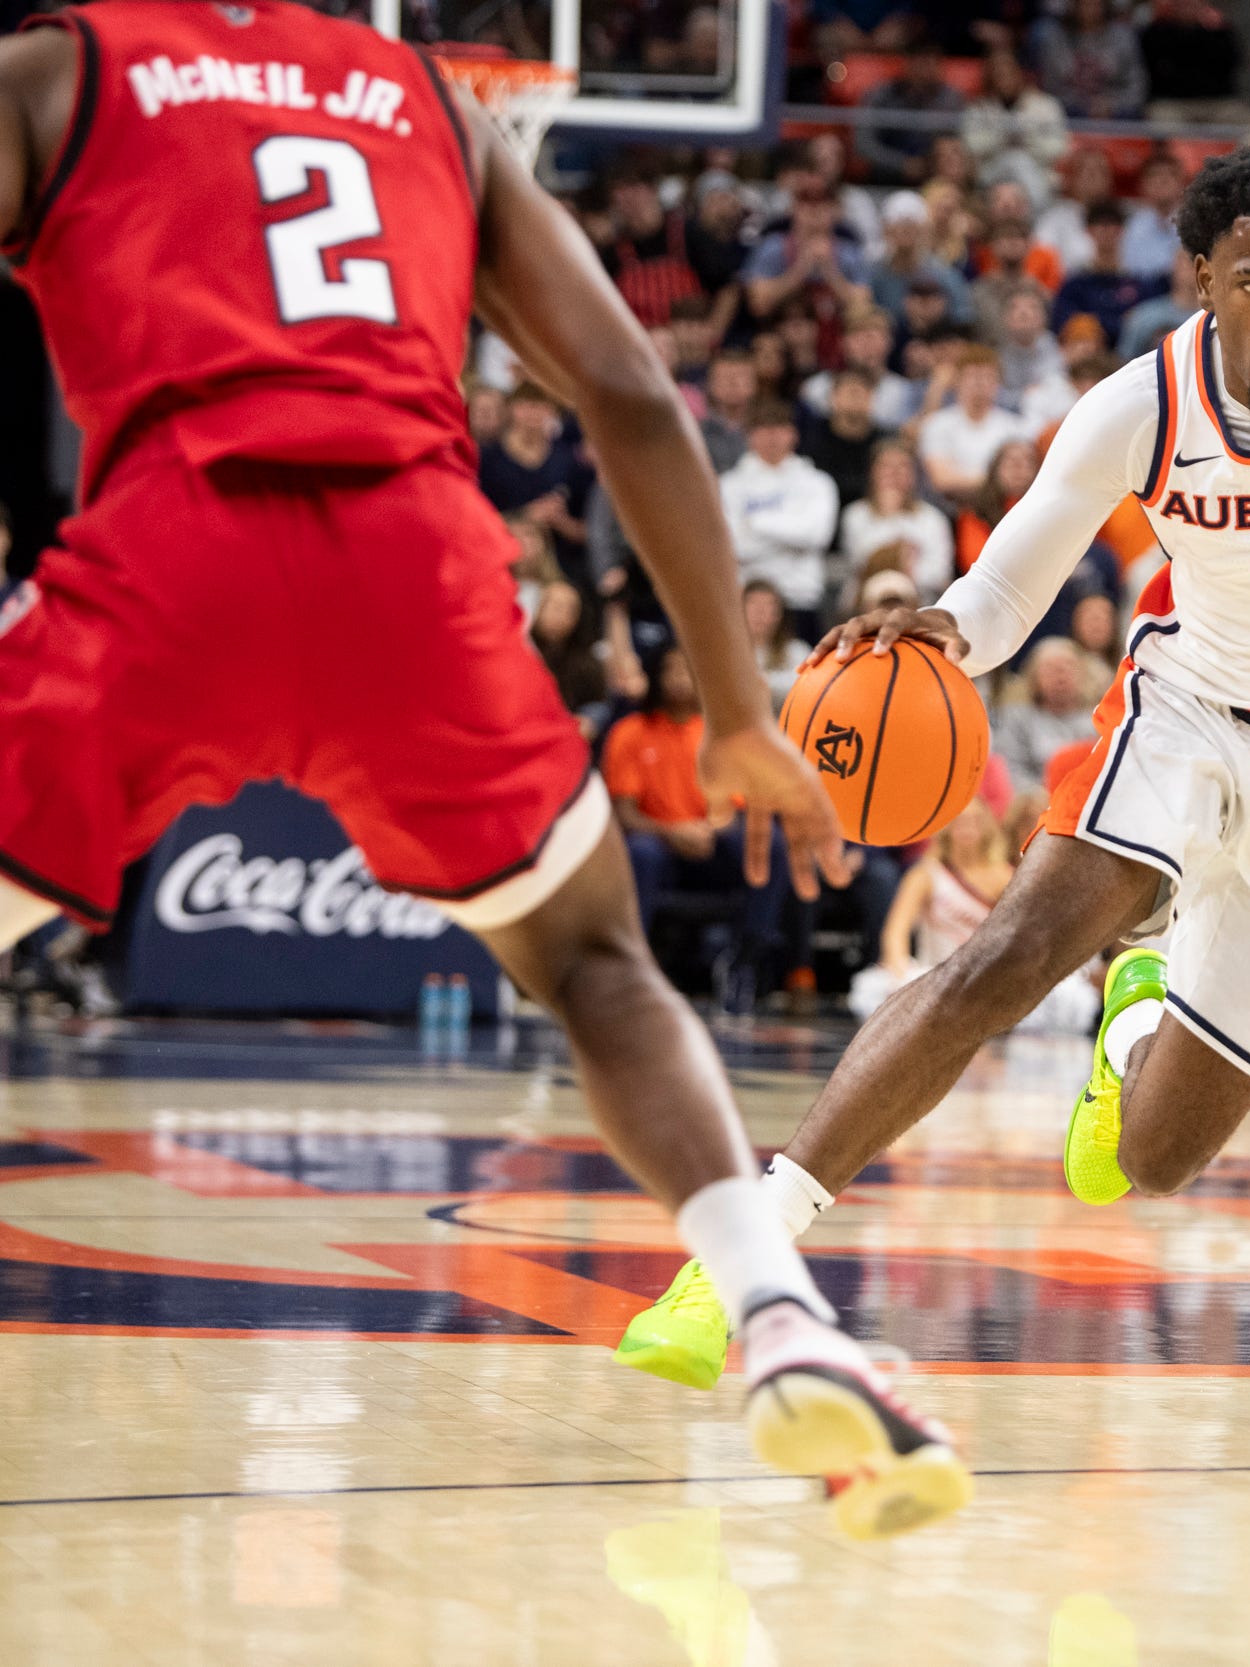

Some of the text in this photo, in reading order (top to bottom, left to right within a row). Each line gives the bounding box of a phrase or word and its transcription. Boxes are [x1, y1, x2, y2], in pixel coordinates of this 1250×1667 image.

[127, 54, 412, 137] McNEIL JR.
[252, 134, 398, 327] 2
